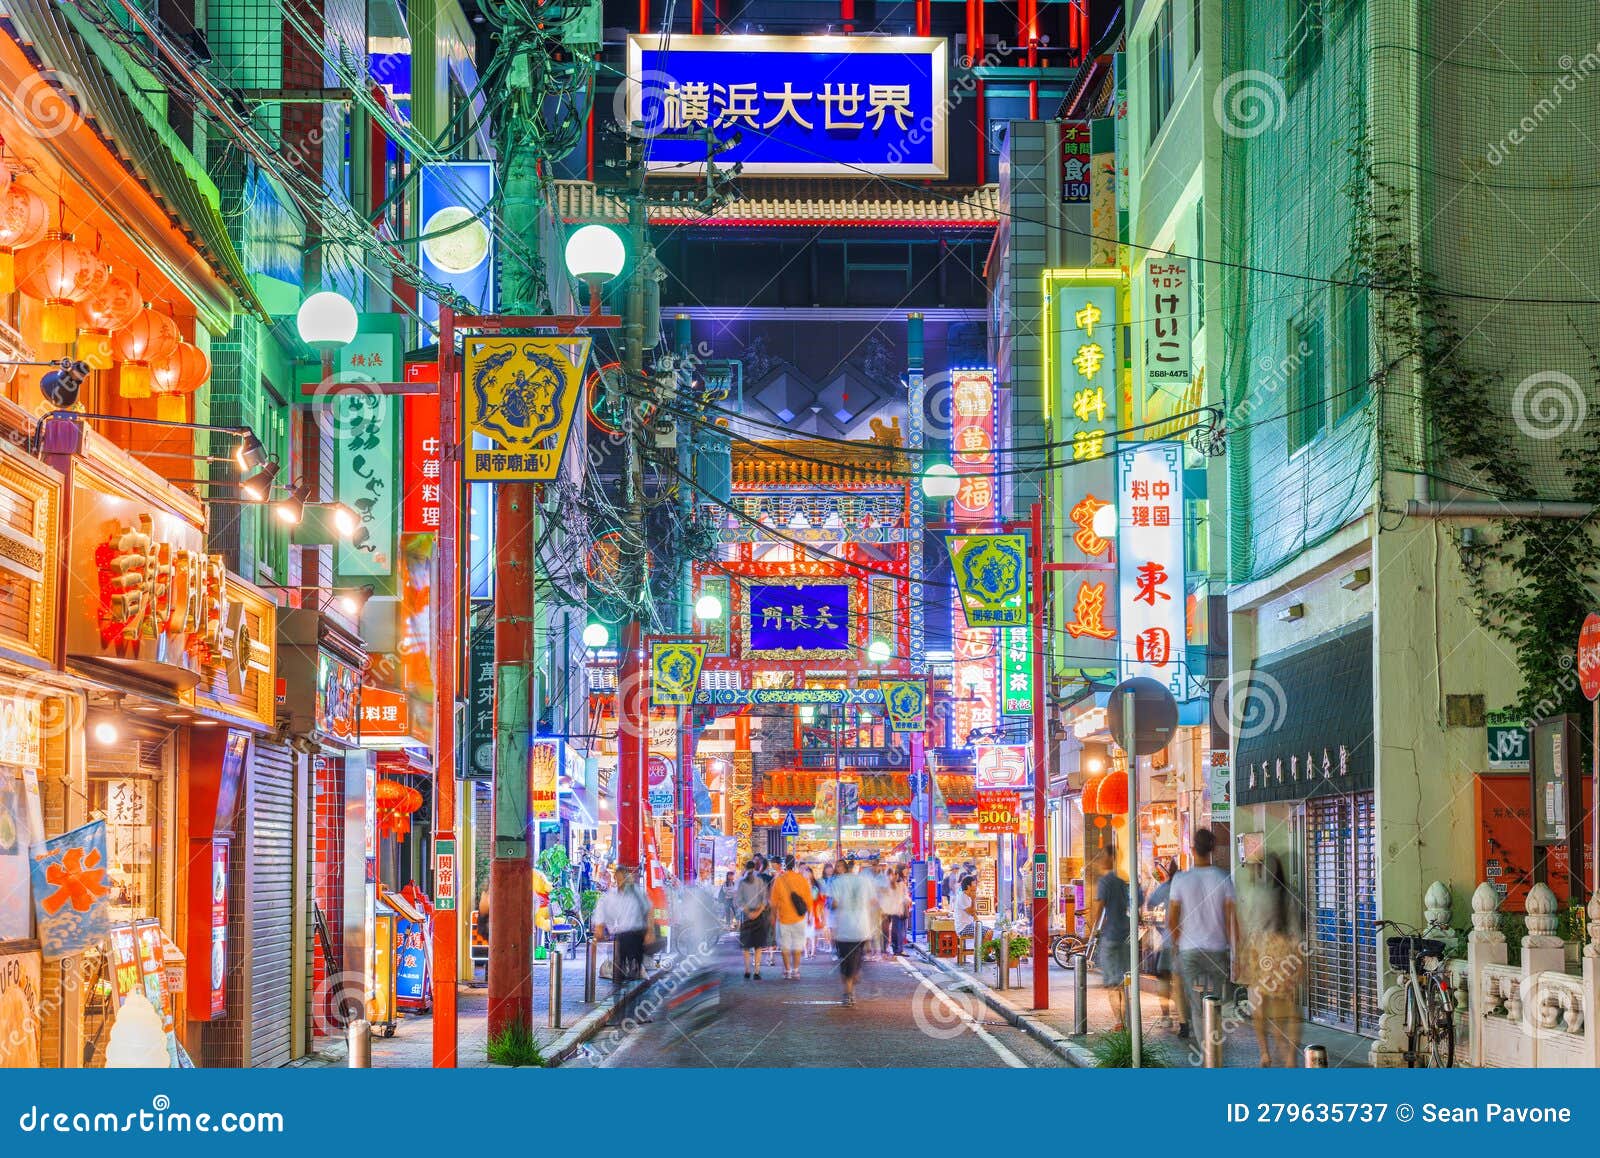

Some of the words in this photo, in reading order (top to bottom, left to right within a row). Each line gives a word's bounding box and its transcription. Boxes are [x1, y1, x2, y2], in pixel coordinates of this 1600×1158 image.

[663, 82, 914, 131] 横浜大世界
[1150, 264, 1185, 275] ビューティー
[1152, 278, 1182, 288] サロン
[1155, 294, 1180, 363] けいこ
[351, 352, 384, 367] 横浜
[1072, 302, 1106, 461] 中華料理
[422, 436, 440, 526] 中華料理
[475, 453, 551, 472] 関帝廟通り
[972, 609, 1022, 622] 関帝廟通り
[1133, 561, 1172, 668] 東園
[984, 746, 1025, 785] 占
[979, 810, 1019, 824] 500円
[438, 855, 452, 897] 関帝廟
[0, 959, 20, 994] UFO
